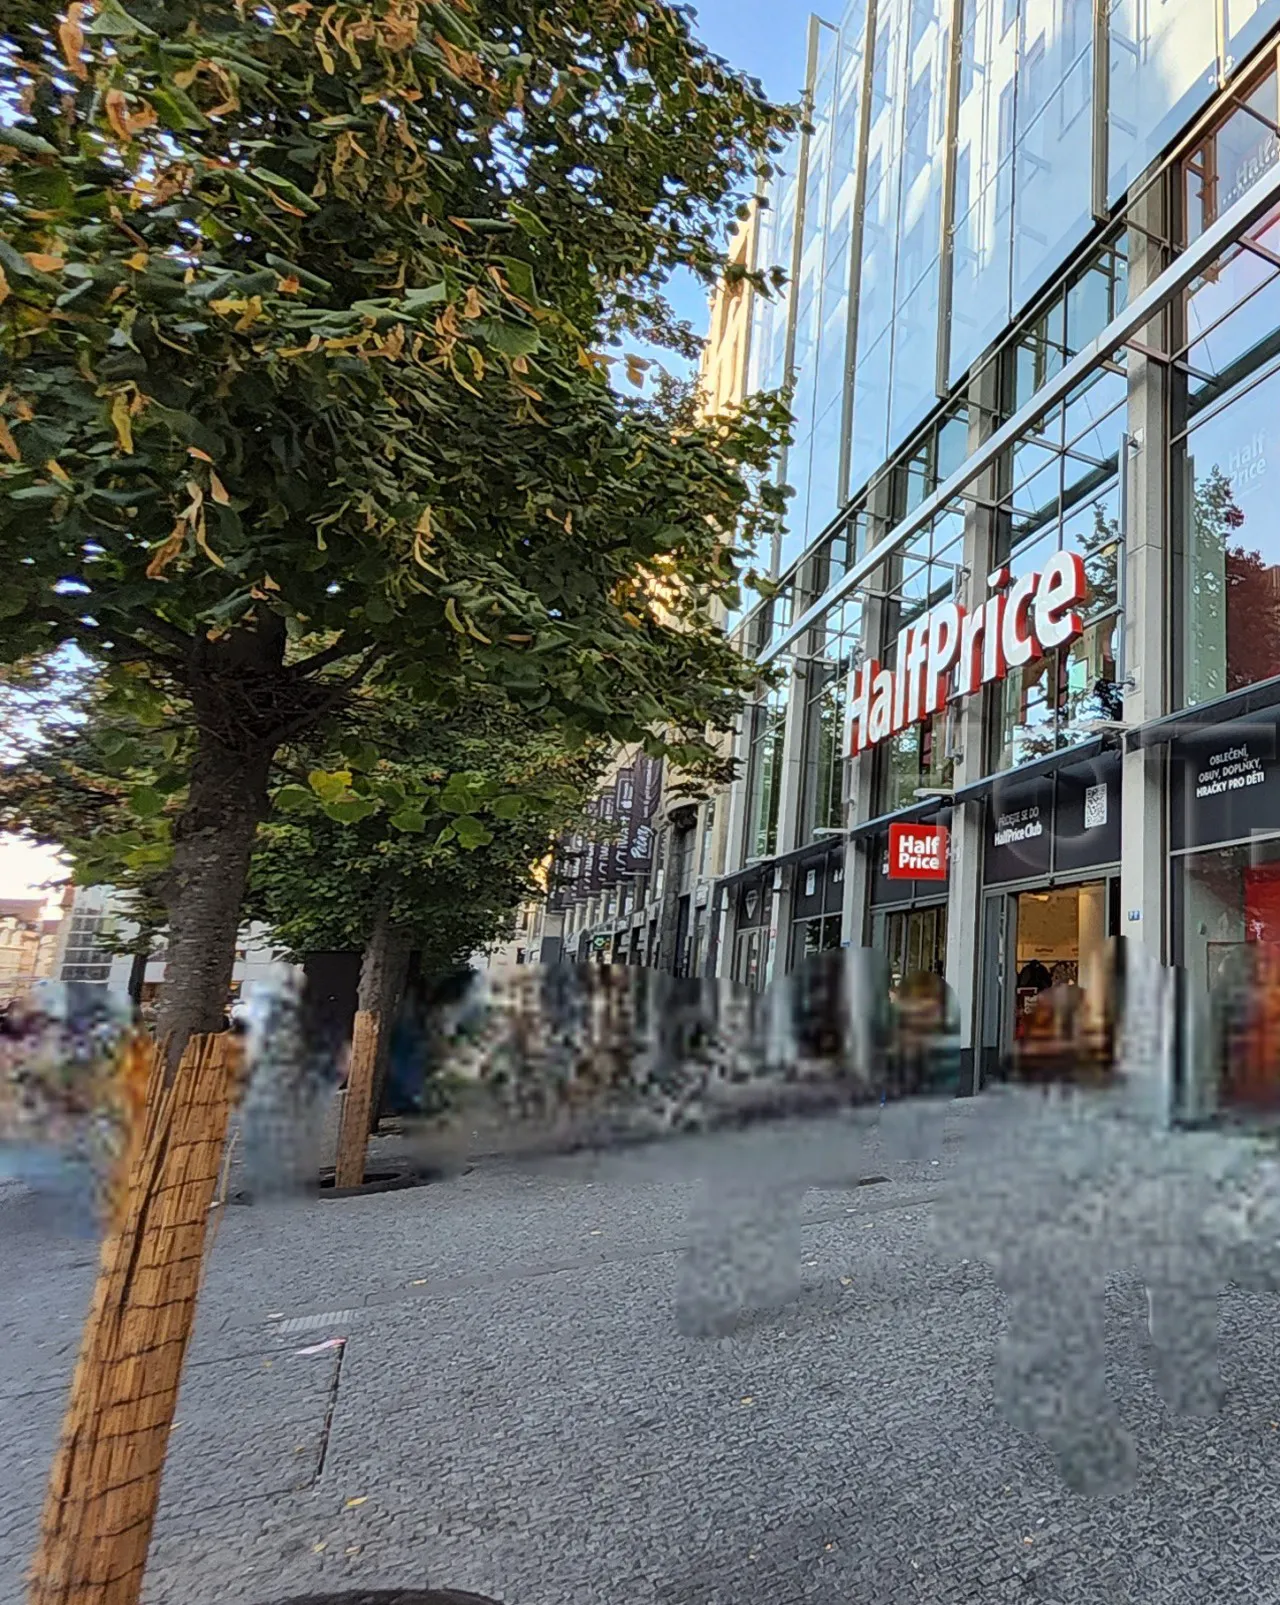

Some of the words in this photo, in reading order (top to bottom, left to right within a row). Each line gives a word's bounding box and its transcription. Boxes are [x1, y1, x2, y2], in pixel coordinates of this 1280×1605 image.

[1228, 428, 1270, 472] Half
[842, 550, 1086, 758] HalfPrice
[1209, 743, 1249, 766] OBLEČENÍ,
[1198, 768, 1221, 783] OBUV,
[1222, 757, 1262, 777] DOPLŇKY,
[1196, 780, 1227, 798] HRAČKY
[1228, 776, 1245, 790] PRO
[1246, 770, 1265, 786] DĚTI
[1029, 806, 1039, 819] DO
[899, 835, 940, 854] Half
[994, 827, 1025, 847] HalfPrice
[1024, 820, 1042, 838] Club
[898, 853, 940, 870] Price
